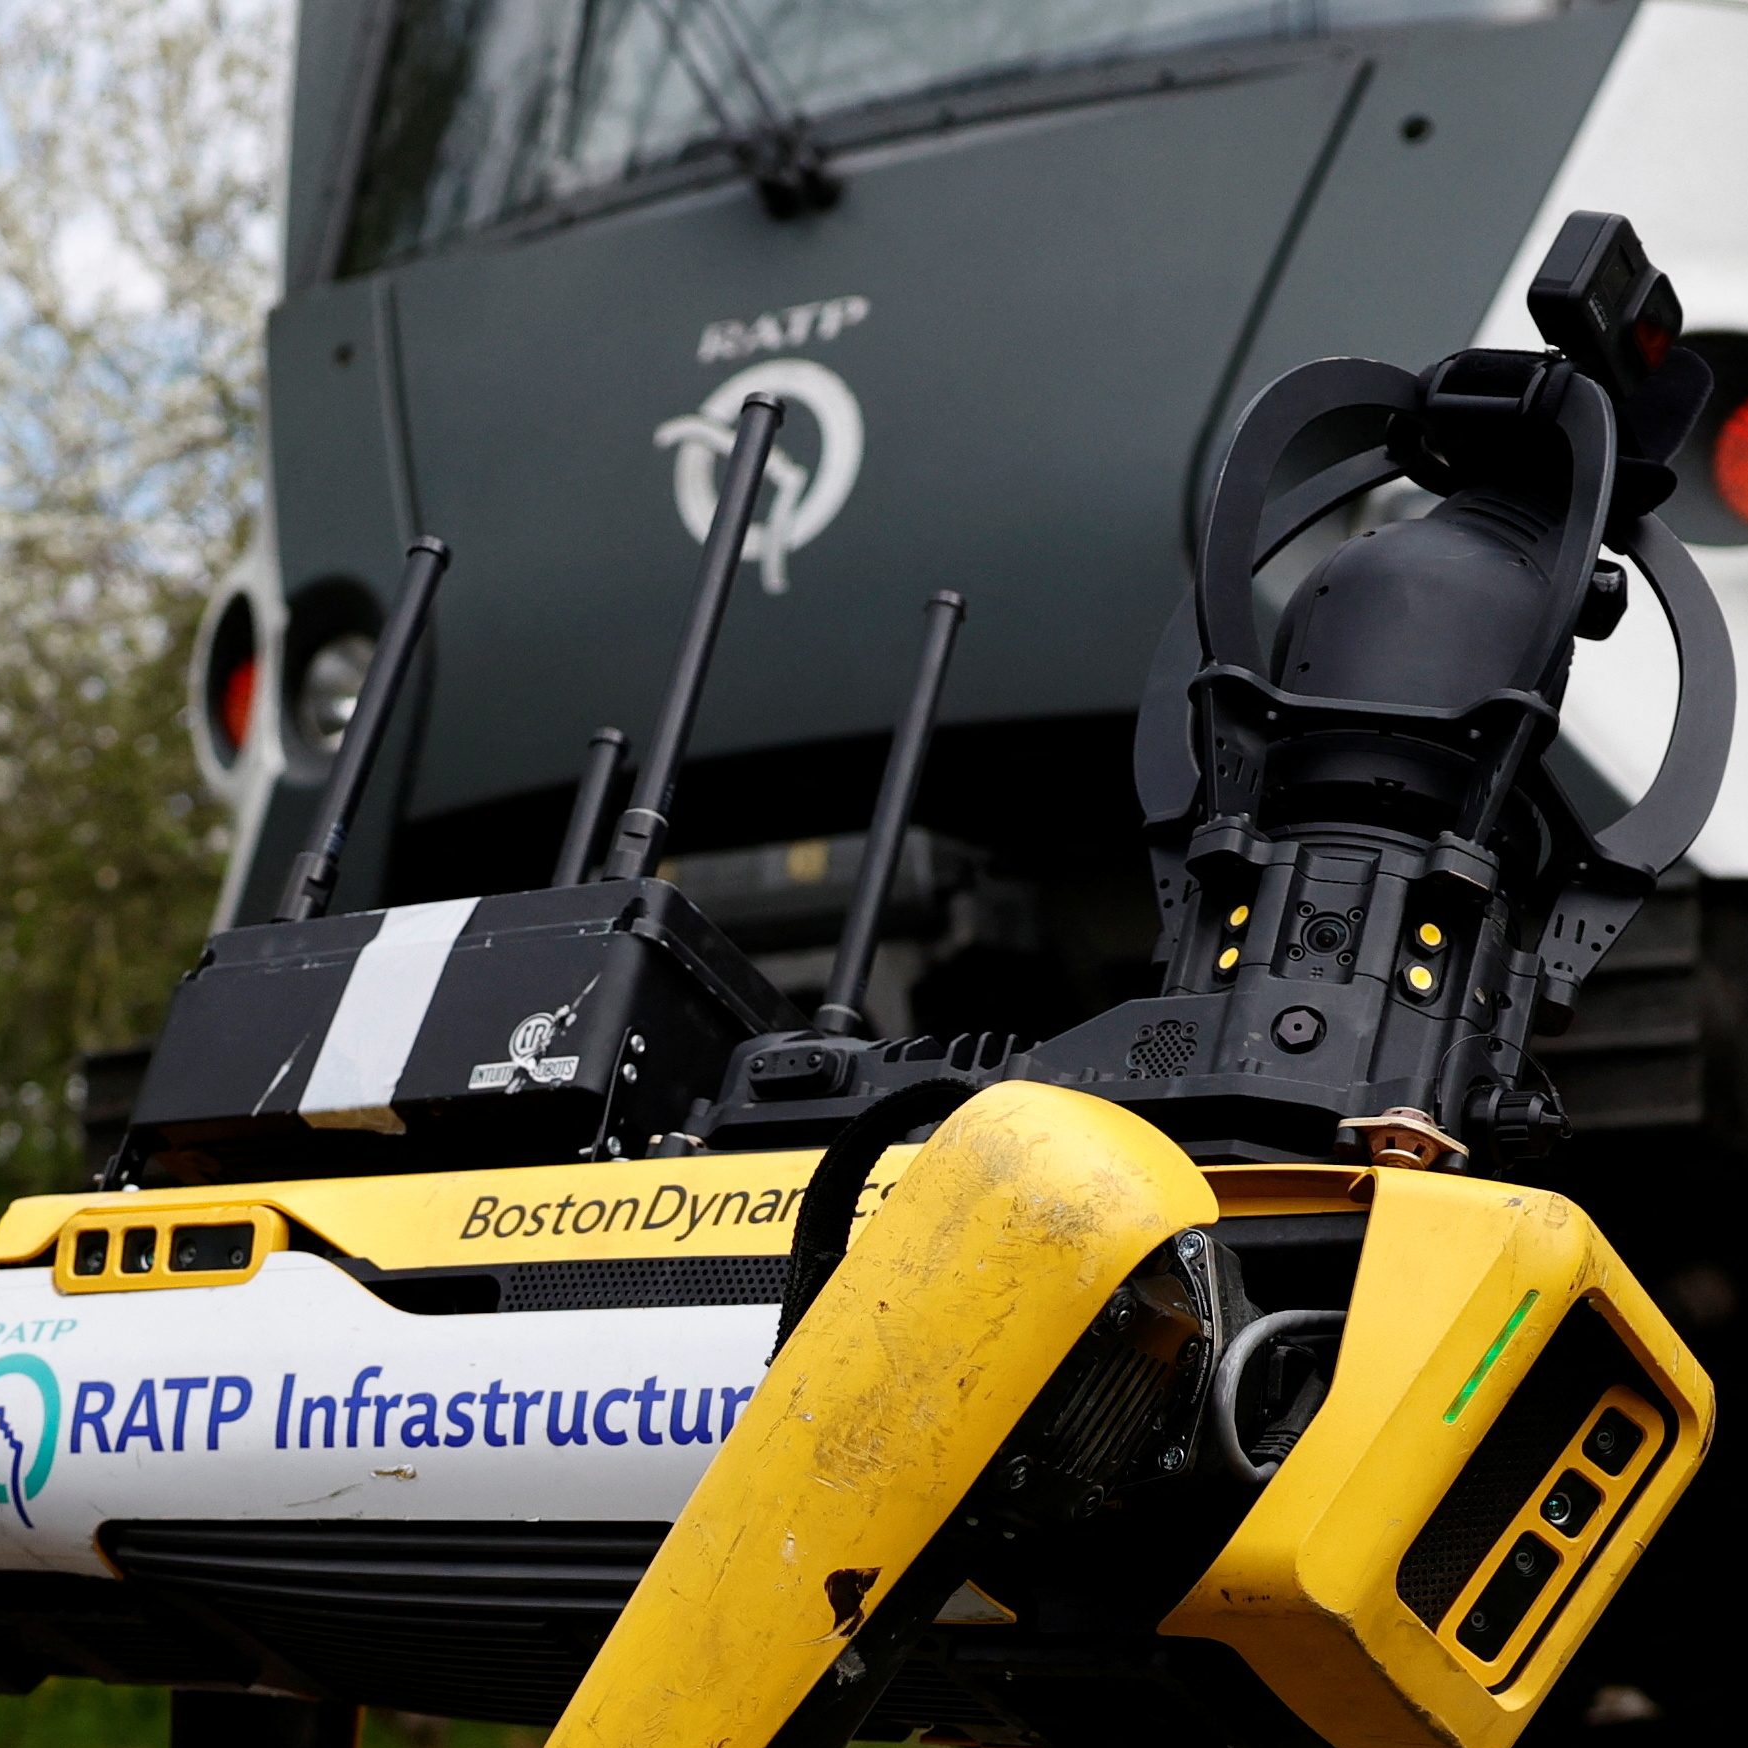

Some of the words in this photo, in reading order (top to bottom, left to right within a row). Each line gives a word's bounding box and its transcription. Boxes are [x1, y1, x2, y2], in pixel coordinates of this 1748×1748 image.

[696, 294, 871, 364] RATP
[69, 1376, 253, 1453] RATP
[274, 1365, 755, 1450] Infrastructur
